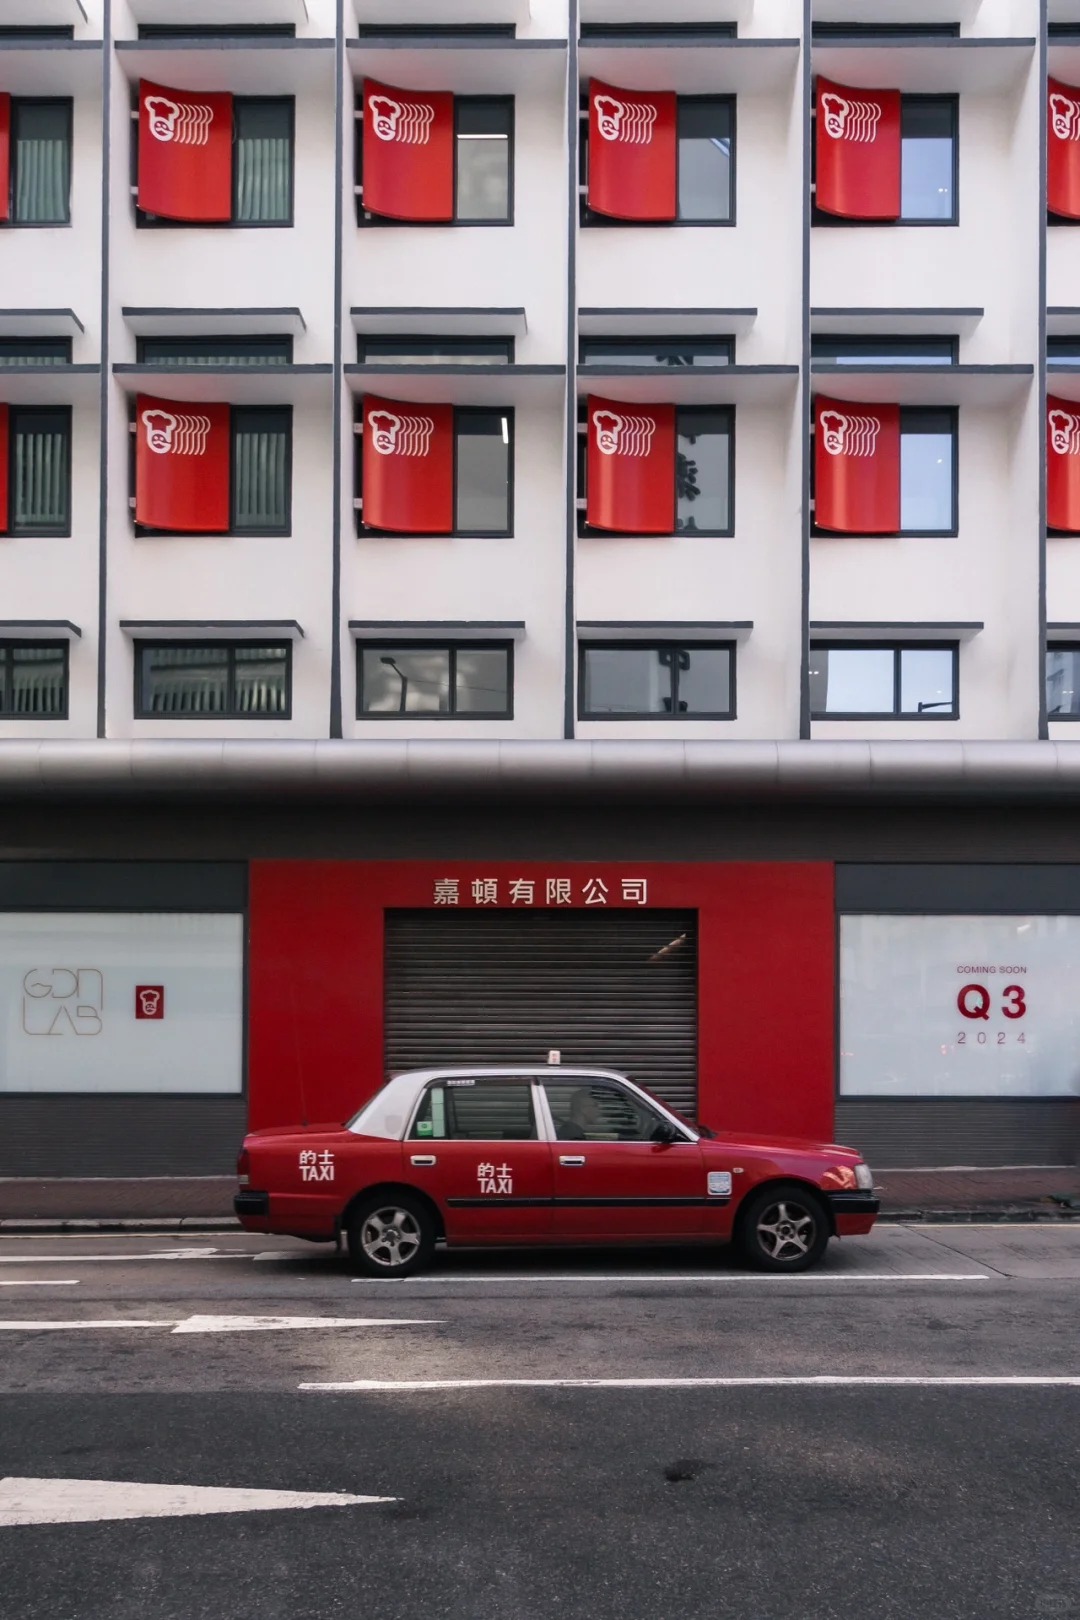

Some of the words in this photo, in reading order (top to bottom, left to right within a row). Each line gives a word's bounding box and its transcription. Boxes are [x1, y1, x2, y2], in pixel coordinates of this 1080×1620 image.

[433, 878, 648, 905] 嘉頓有限公司
[957, 965, 996, 974] COMING
[999, 965, 1027, 974] SOON
[23, 997, 103, 1036] LAB
[299, 1150, 335, 1165] 的士
[299, 1166, 335, 1181] TAXI
[477, 1163, 513, 1178] 的士
[477, 1178, 513, 1194] TAXI
